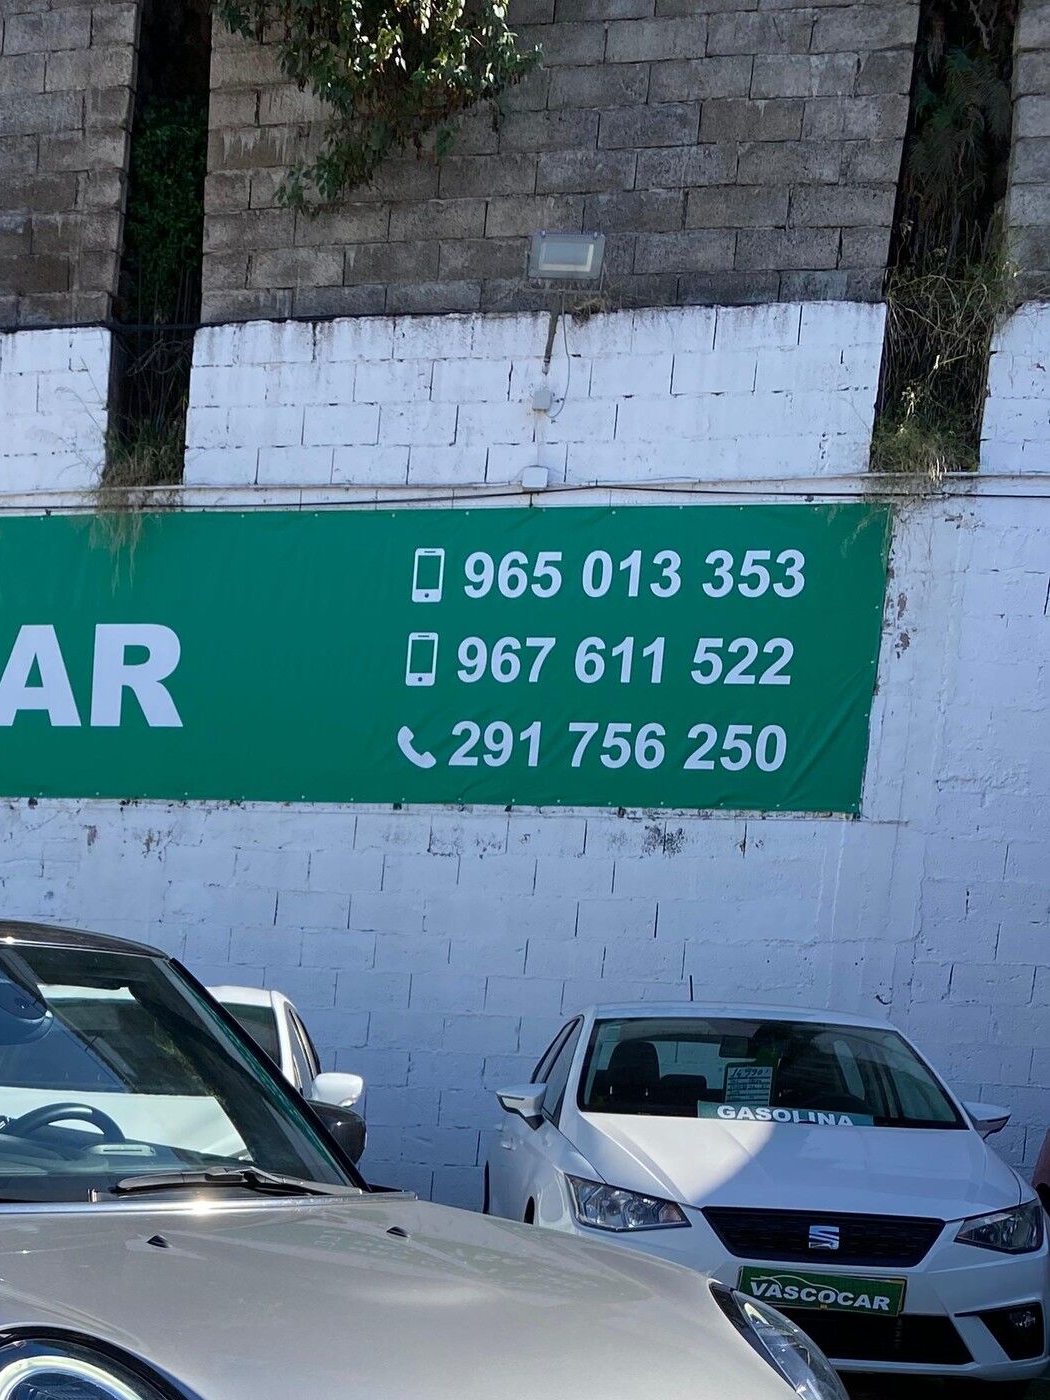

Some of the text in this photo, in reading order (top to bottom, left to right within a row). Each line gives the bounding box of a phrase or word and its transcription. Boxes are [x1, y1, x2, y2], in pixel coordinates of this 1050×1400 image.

[464, 549, 805, 599] 965 013 353
[457, 636, 794, 685] 967 611 522
[448, 720, 788, 772] 291 756 250
[717, 1105, 854, 1126] GASOLINA
[750, 1281, 890, 1311] VASCOCAR
